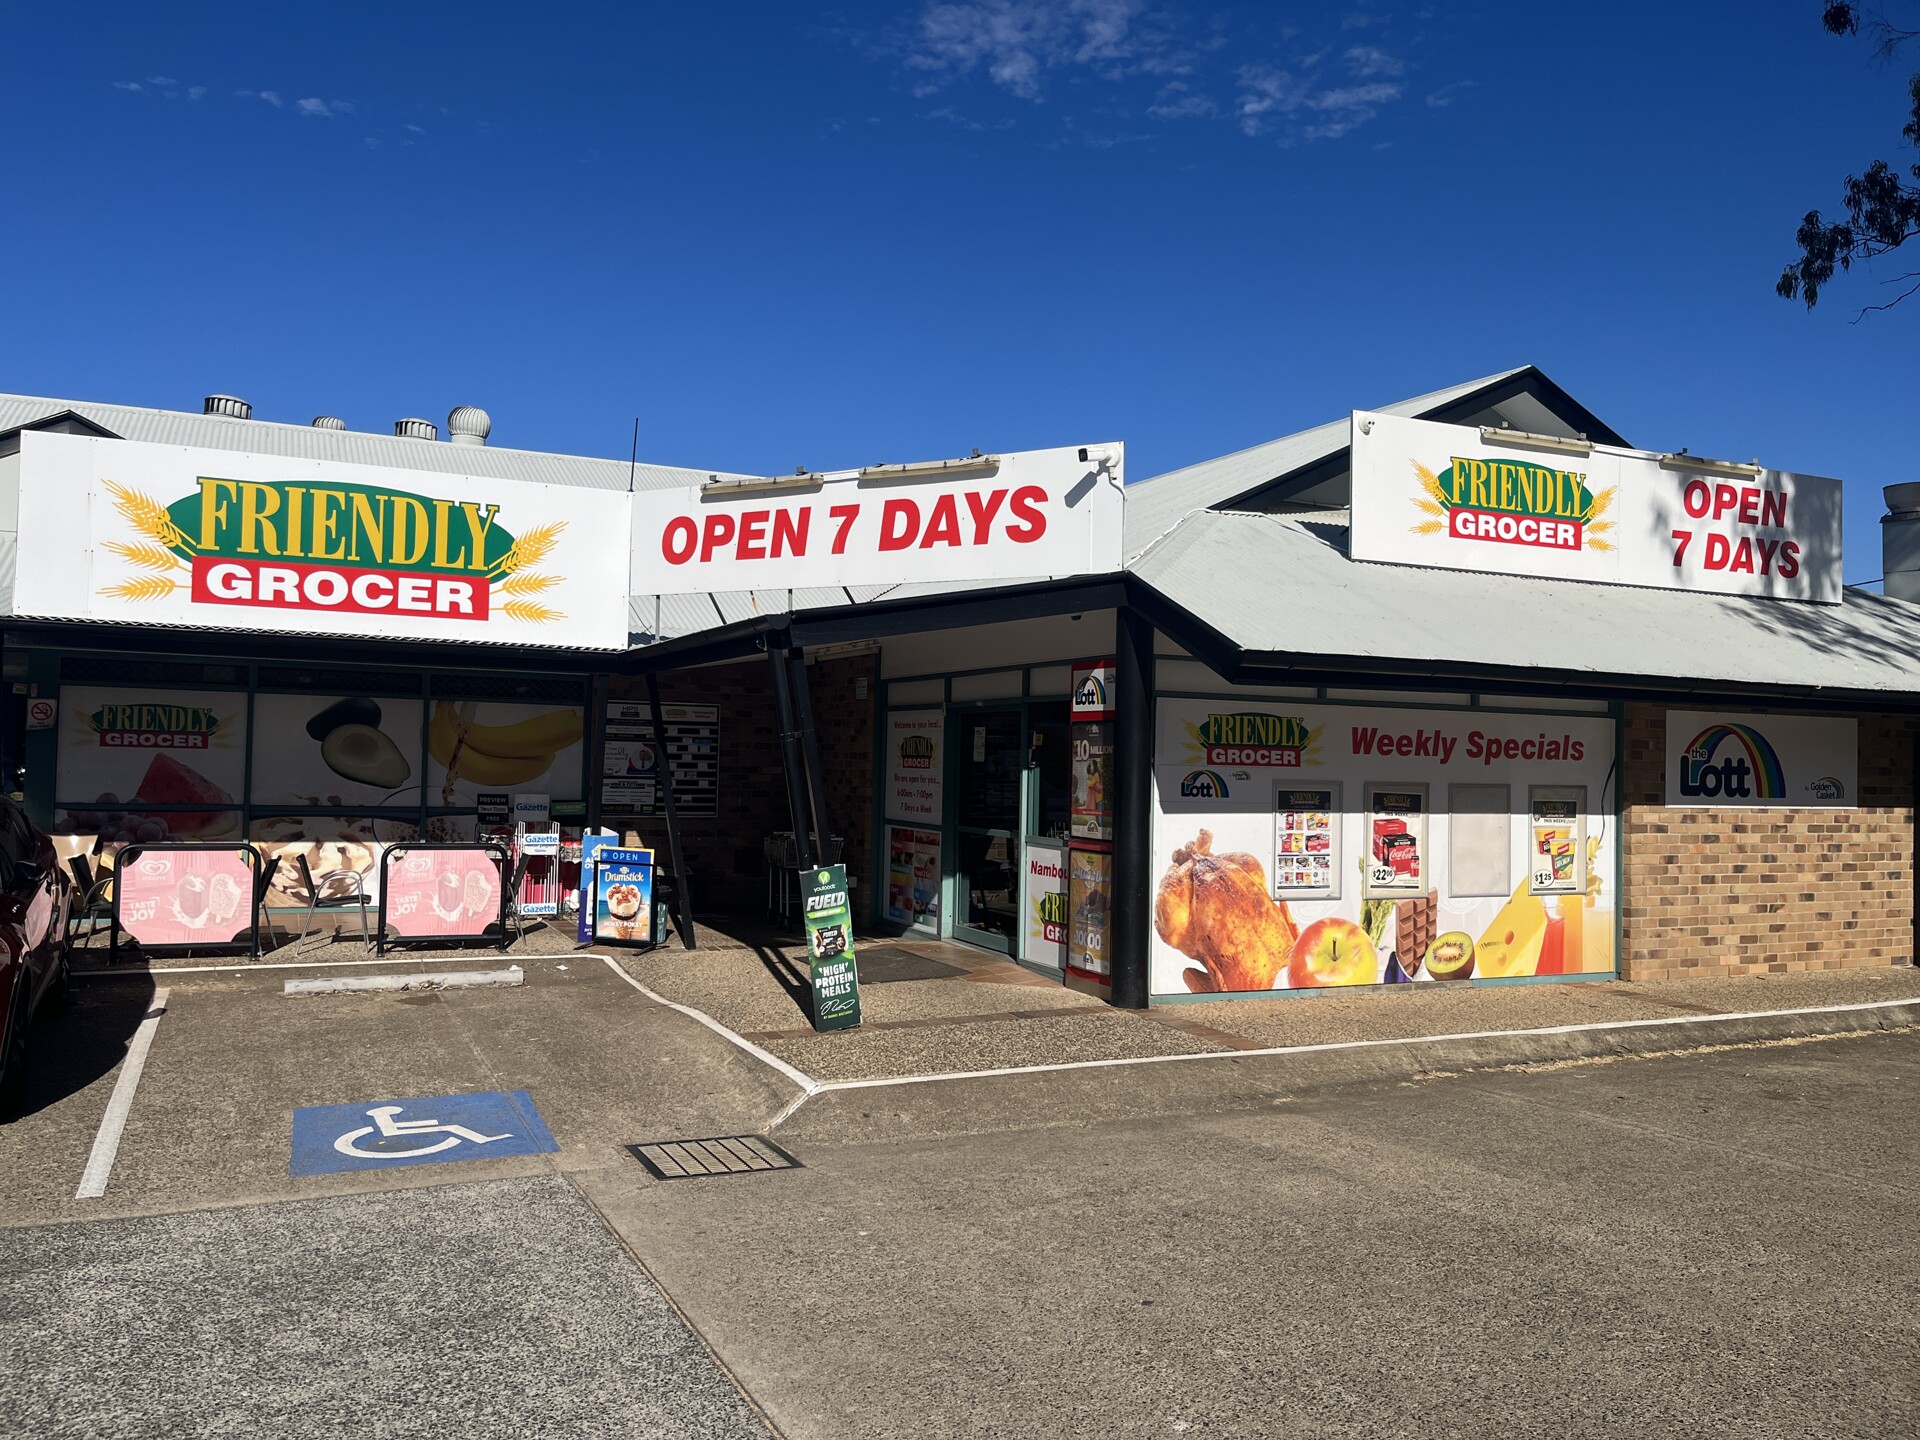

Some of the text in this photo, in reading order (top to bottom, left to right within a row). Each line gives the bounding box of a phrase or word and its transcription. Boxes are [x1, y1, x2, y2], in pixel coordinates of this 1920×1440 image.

[1450, 456, 1587, 517] FRIENDLY
[1683, 480, 1788, 528] OPEN
[197, 477, 500, 571] FRIENDLY
[661, 485, 1049, 565] OPEN 7 DAYS
[1455, 511, 1576, 548] GROCER
[1671, 530, 1800, 579] 7 DAYS
[206, 565, 474, 614] GROCER
[1075, 689, 1096, 705] Lott
[101, 704, 212, 732] FRIENDLY
[1207, 713, 1305, 748] FRIENDLY
[105, 732, 204, 748] GROCER
[903, 738, 932, 755] FRIENDLY
[1351, 726, 1584, 765] Weekly Specials
[1212, 749, 1297, 765] GROCER
[1691, 747, 1707, 759] the
[903, 759, 930, 768] GROCER
[1680, 755, 1750, 797] Lott
[1181, 782, 1212, 797] Lott
[1810, 783, 1832, 791] Golden
[1816, 791, 1835, 799] Casket
[516, 803, 548, 811] Gazette
[525, 835, 558, 843] Gazette
[612, 853, 638, 861] OPEN
[605, 872, 644, 882] Drumstick
[129, 900, 157, 909] TASTE
[395, 895, 419, 904] TASTE
[806, 891, 846, 911] FUEL'D
[130, 908, 156, 922] JOY
[395, 903, 418, 916] JOY
[522, 905, 556, 914] Gazette
[815, 972, 854, 989] PROTEIN
[821, 983, 851, 998] MEALS
